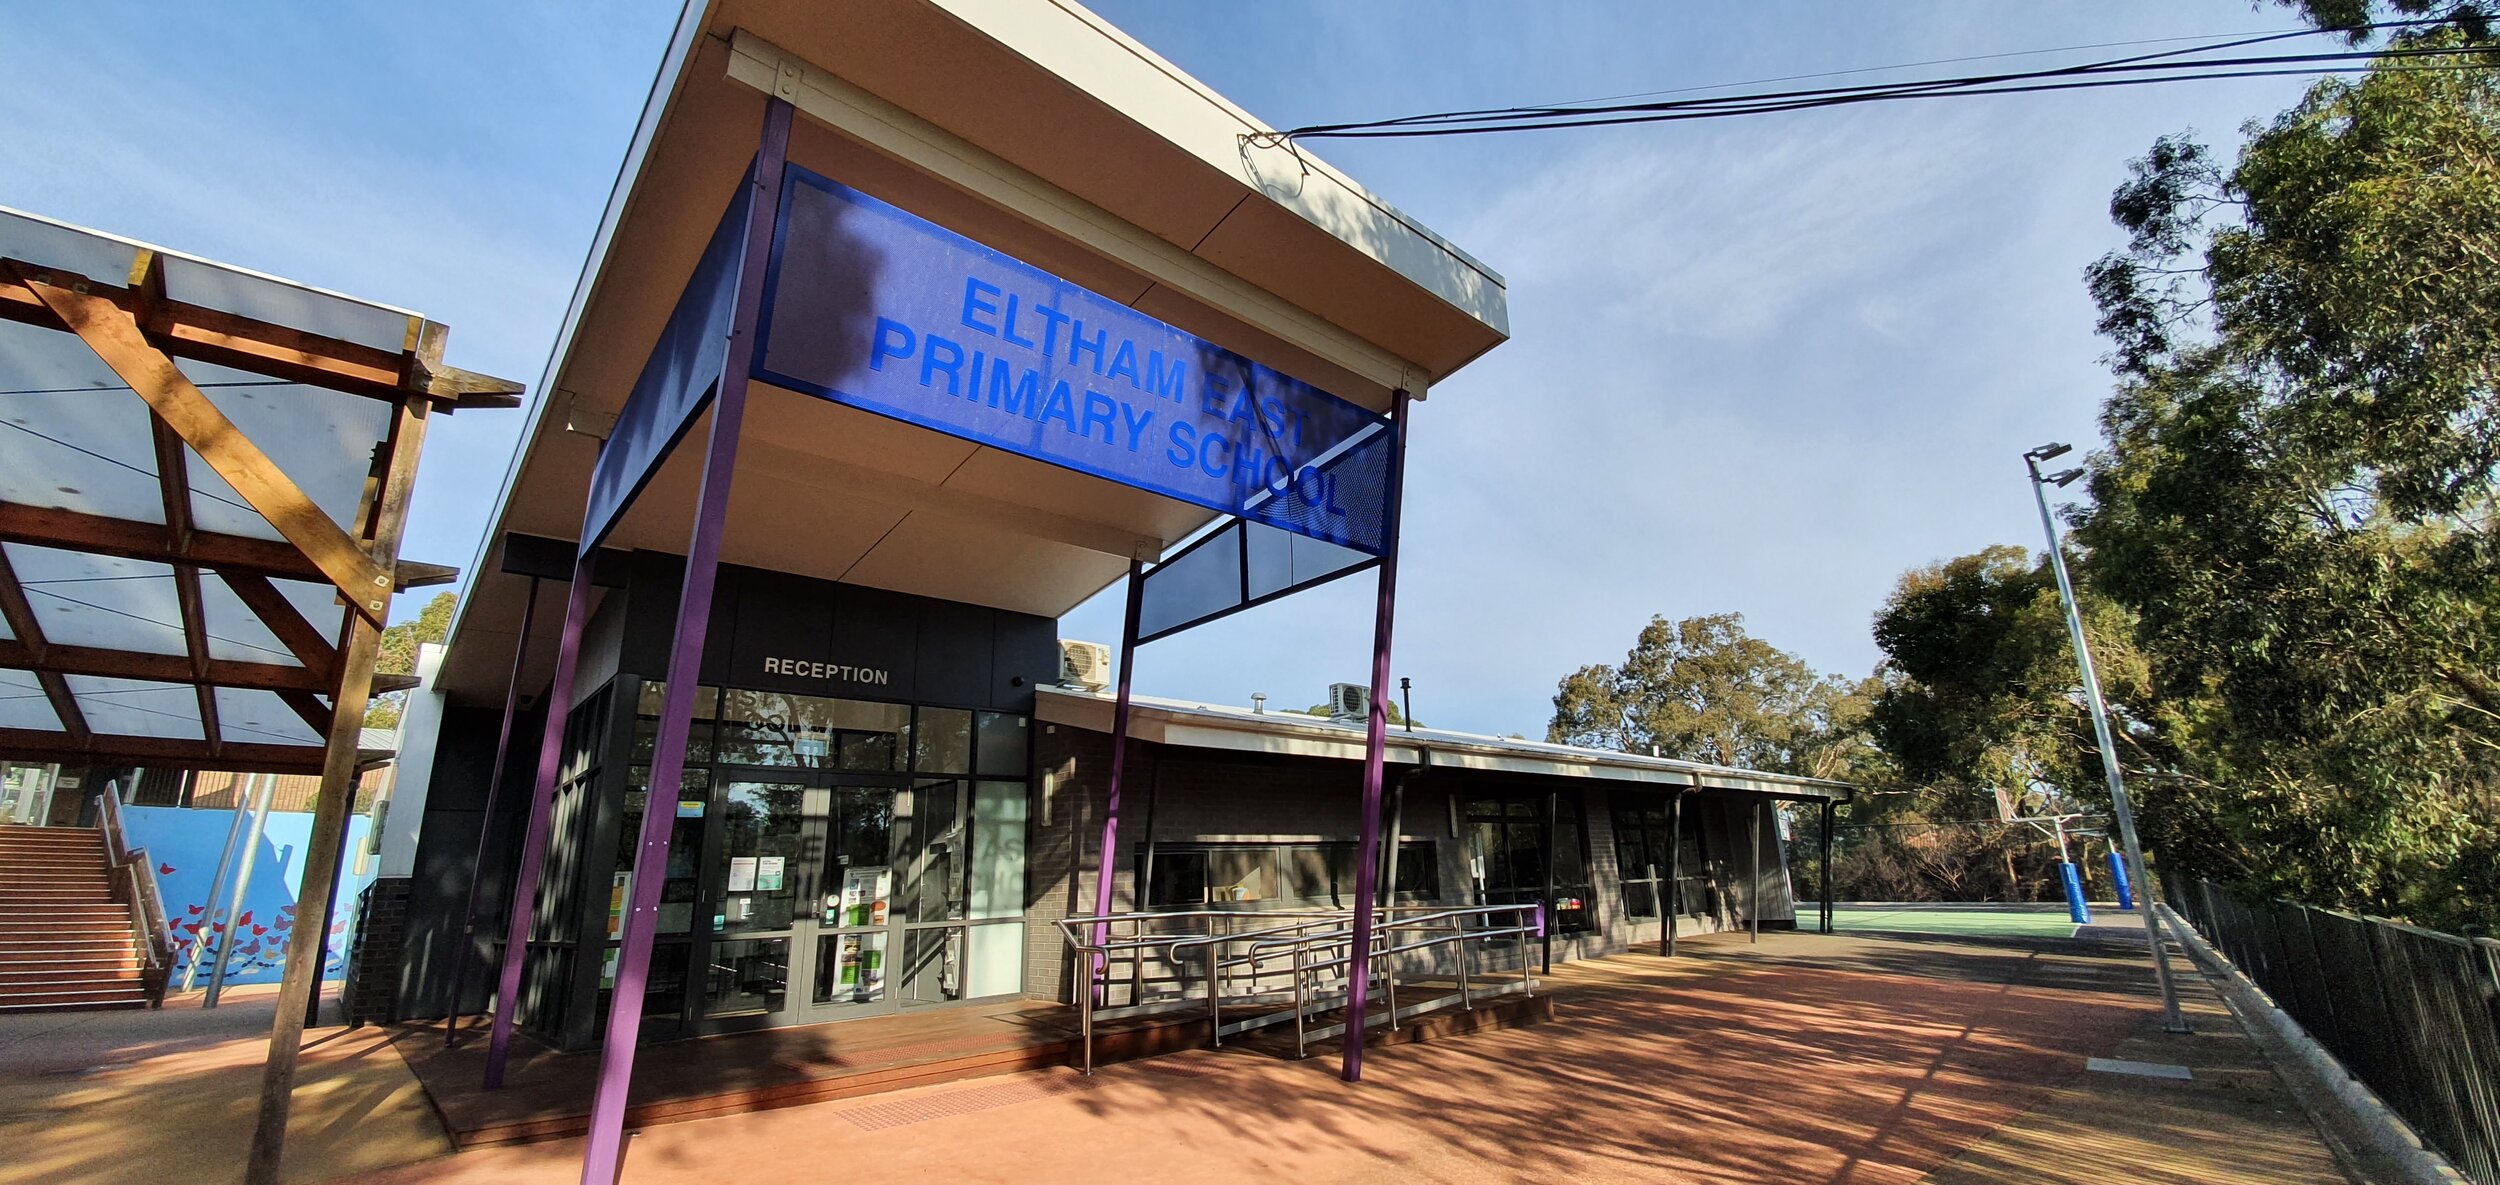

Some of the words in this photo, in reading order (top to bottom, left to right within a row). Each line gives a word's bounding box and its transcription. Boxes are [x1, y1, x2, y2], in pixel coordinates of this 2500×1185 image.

[870, 317, 1154, 452] PRIMARY
[1167, 421, 1346, 517] SCHOOL
[961, 277, 1185, 404] ELTHAM
[1202, 372, 1309, 446] EAST
[764, 657, 888, 685] RECEPTION
